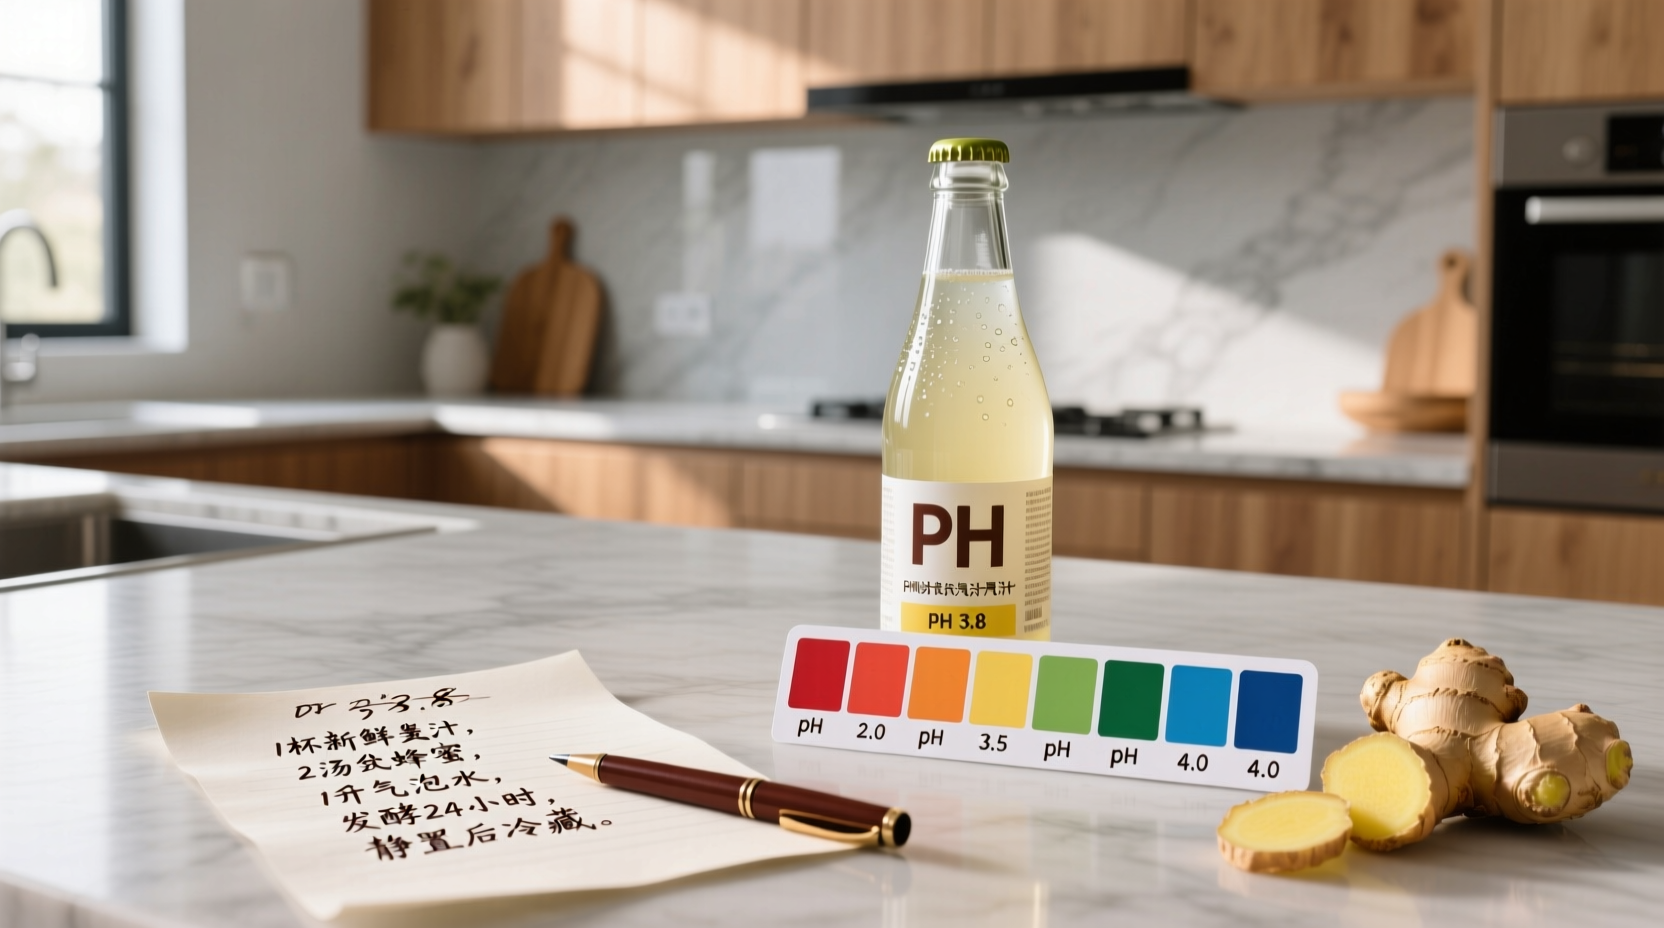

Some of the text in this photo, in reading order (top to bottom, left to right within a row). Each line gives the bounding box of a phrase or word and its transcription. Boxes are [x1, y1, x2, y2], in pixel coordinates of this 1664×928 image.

[912, 503, 1005, 569] PH
[928, 612, 987, 630] PH 3.8
[797, 717, 1280, 779] pH 2.0 pH 3.5 pH pH 4.0 4.0
